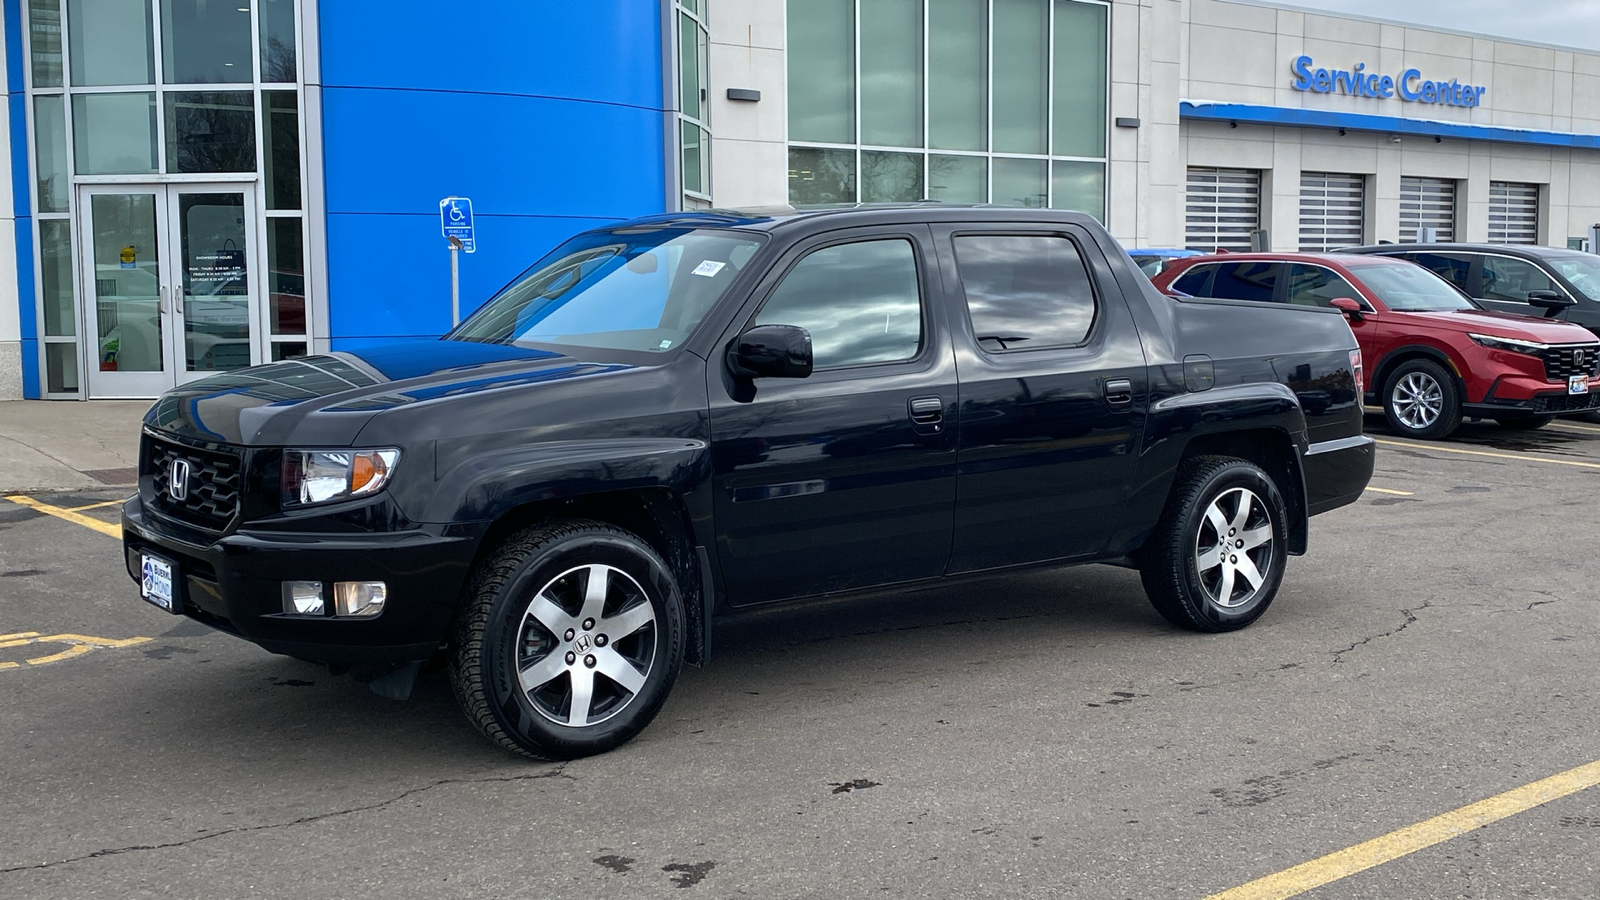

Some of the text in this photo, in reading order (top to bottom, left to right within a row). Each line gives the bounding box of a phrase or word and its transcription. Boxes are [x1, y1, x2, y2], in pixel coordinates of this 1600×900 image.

[1292, 55, 1486, 107] Service Center
[154, 564, 171, 581] BUERKL
[154, 573, 171, 597] HOND
